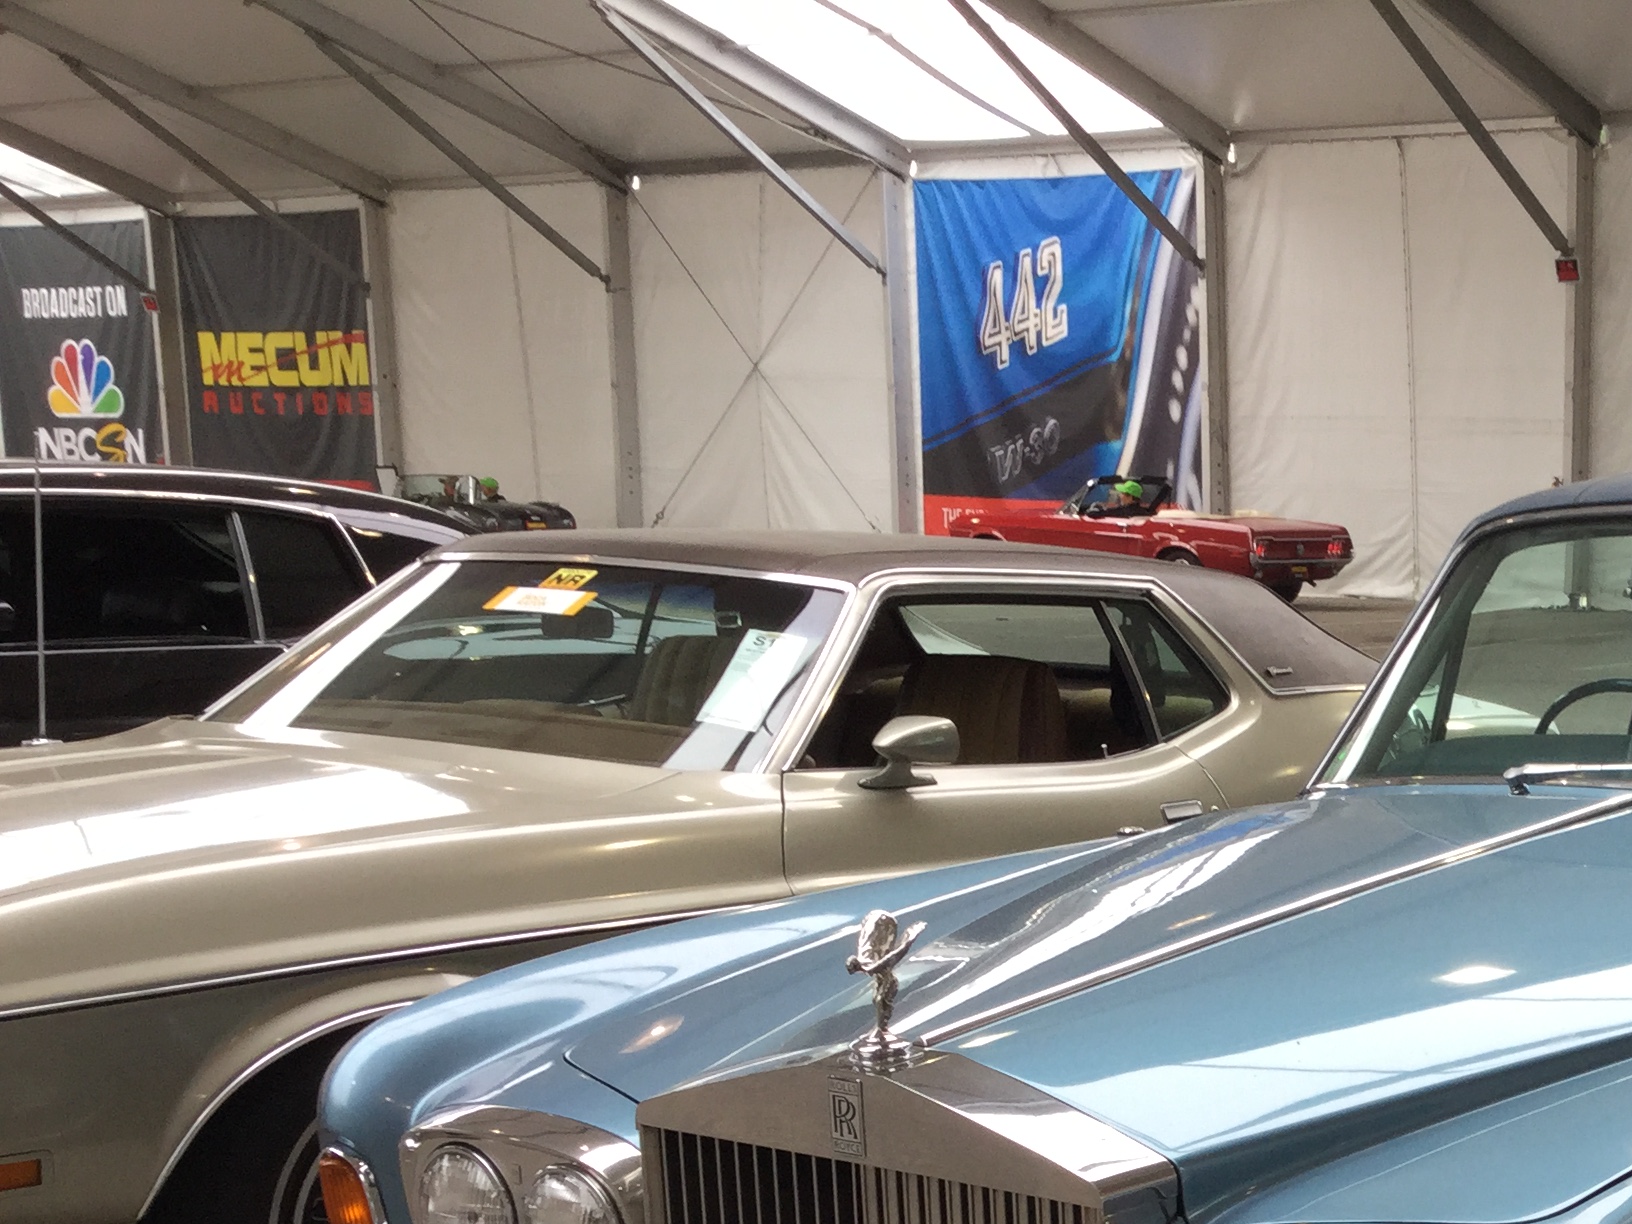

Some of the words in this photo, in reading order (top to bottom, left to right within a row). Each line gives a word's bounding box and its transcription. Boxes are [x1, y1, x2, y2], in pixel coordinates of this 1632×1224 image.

[21, 286, 103, 320] BROADCAST
[104, 285, 128, 318] ON
[977, 235, 1068, 370] 442
[197, 329, 370, 388] MECUM
[202, 391, 373, 416] AUCTIONS
[36, 422, 147, 466] NBCSN
